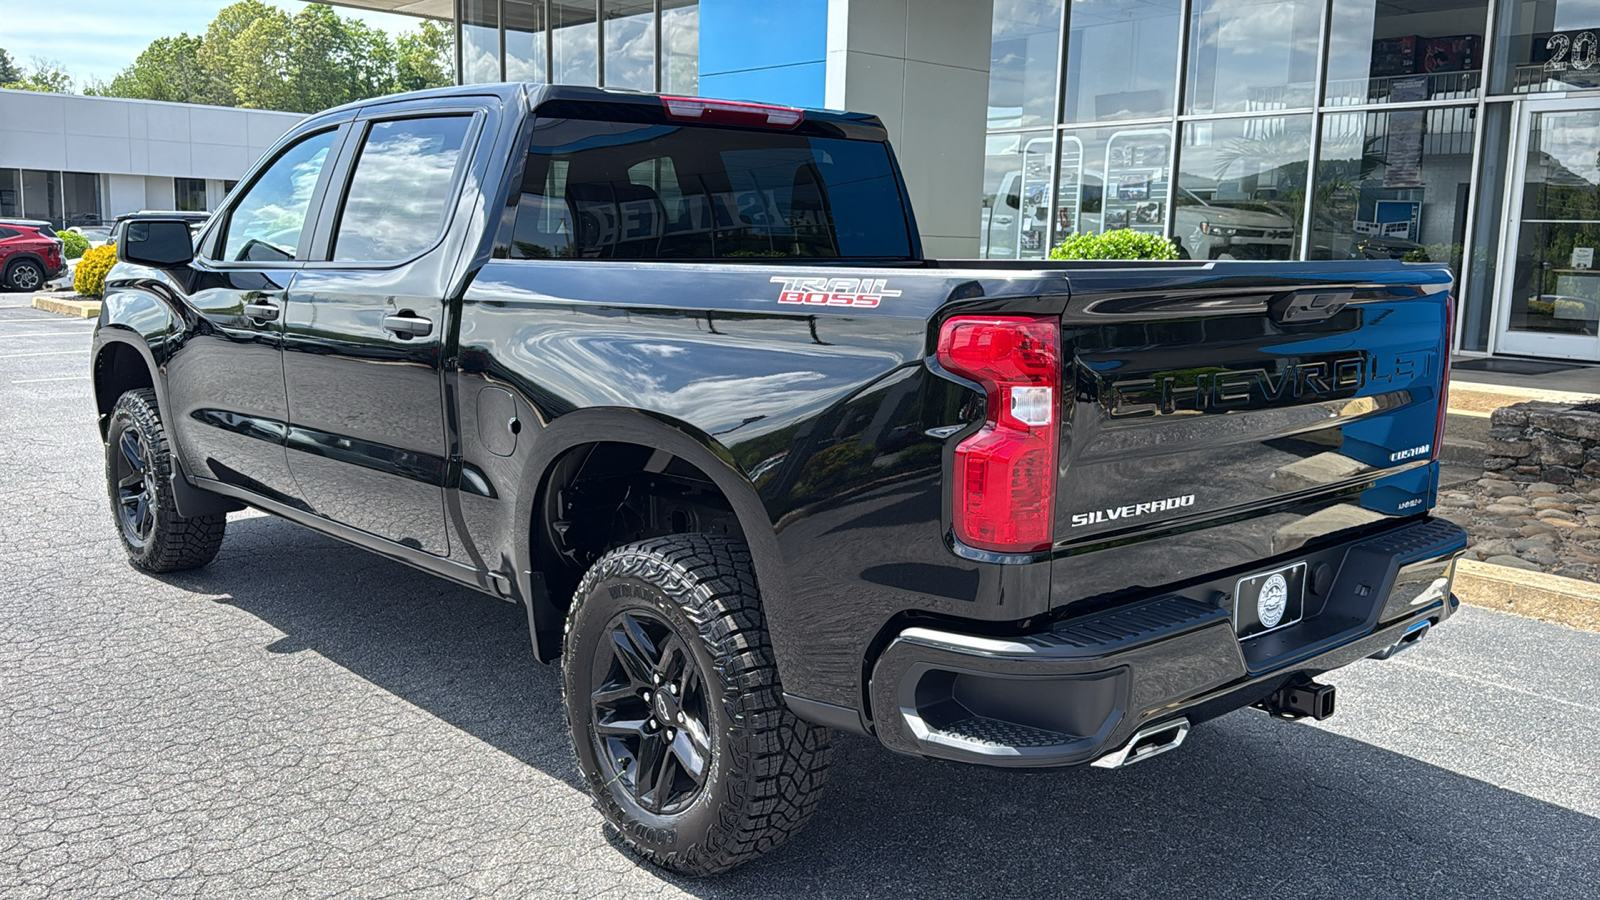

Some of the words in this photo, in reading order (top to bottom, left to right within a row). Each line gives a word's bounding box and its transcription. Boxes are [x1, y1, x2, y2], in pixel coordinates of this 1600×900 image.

[1544, 31, 1600, 72] 20
[770, 276, 902, 298] TRAIL
[778, 291, 882, 308] BOSS
[1110, 349, 1437, 420] CHEVROLET
[1389, 444, 1430, 462] CUSTOM
[1071, 494, 1195, 528] SILVERADO
